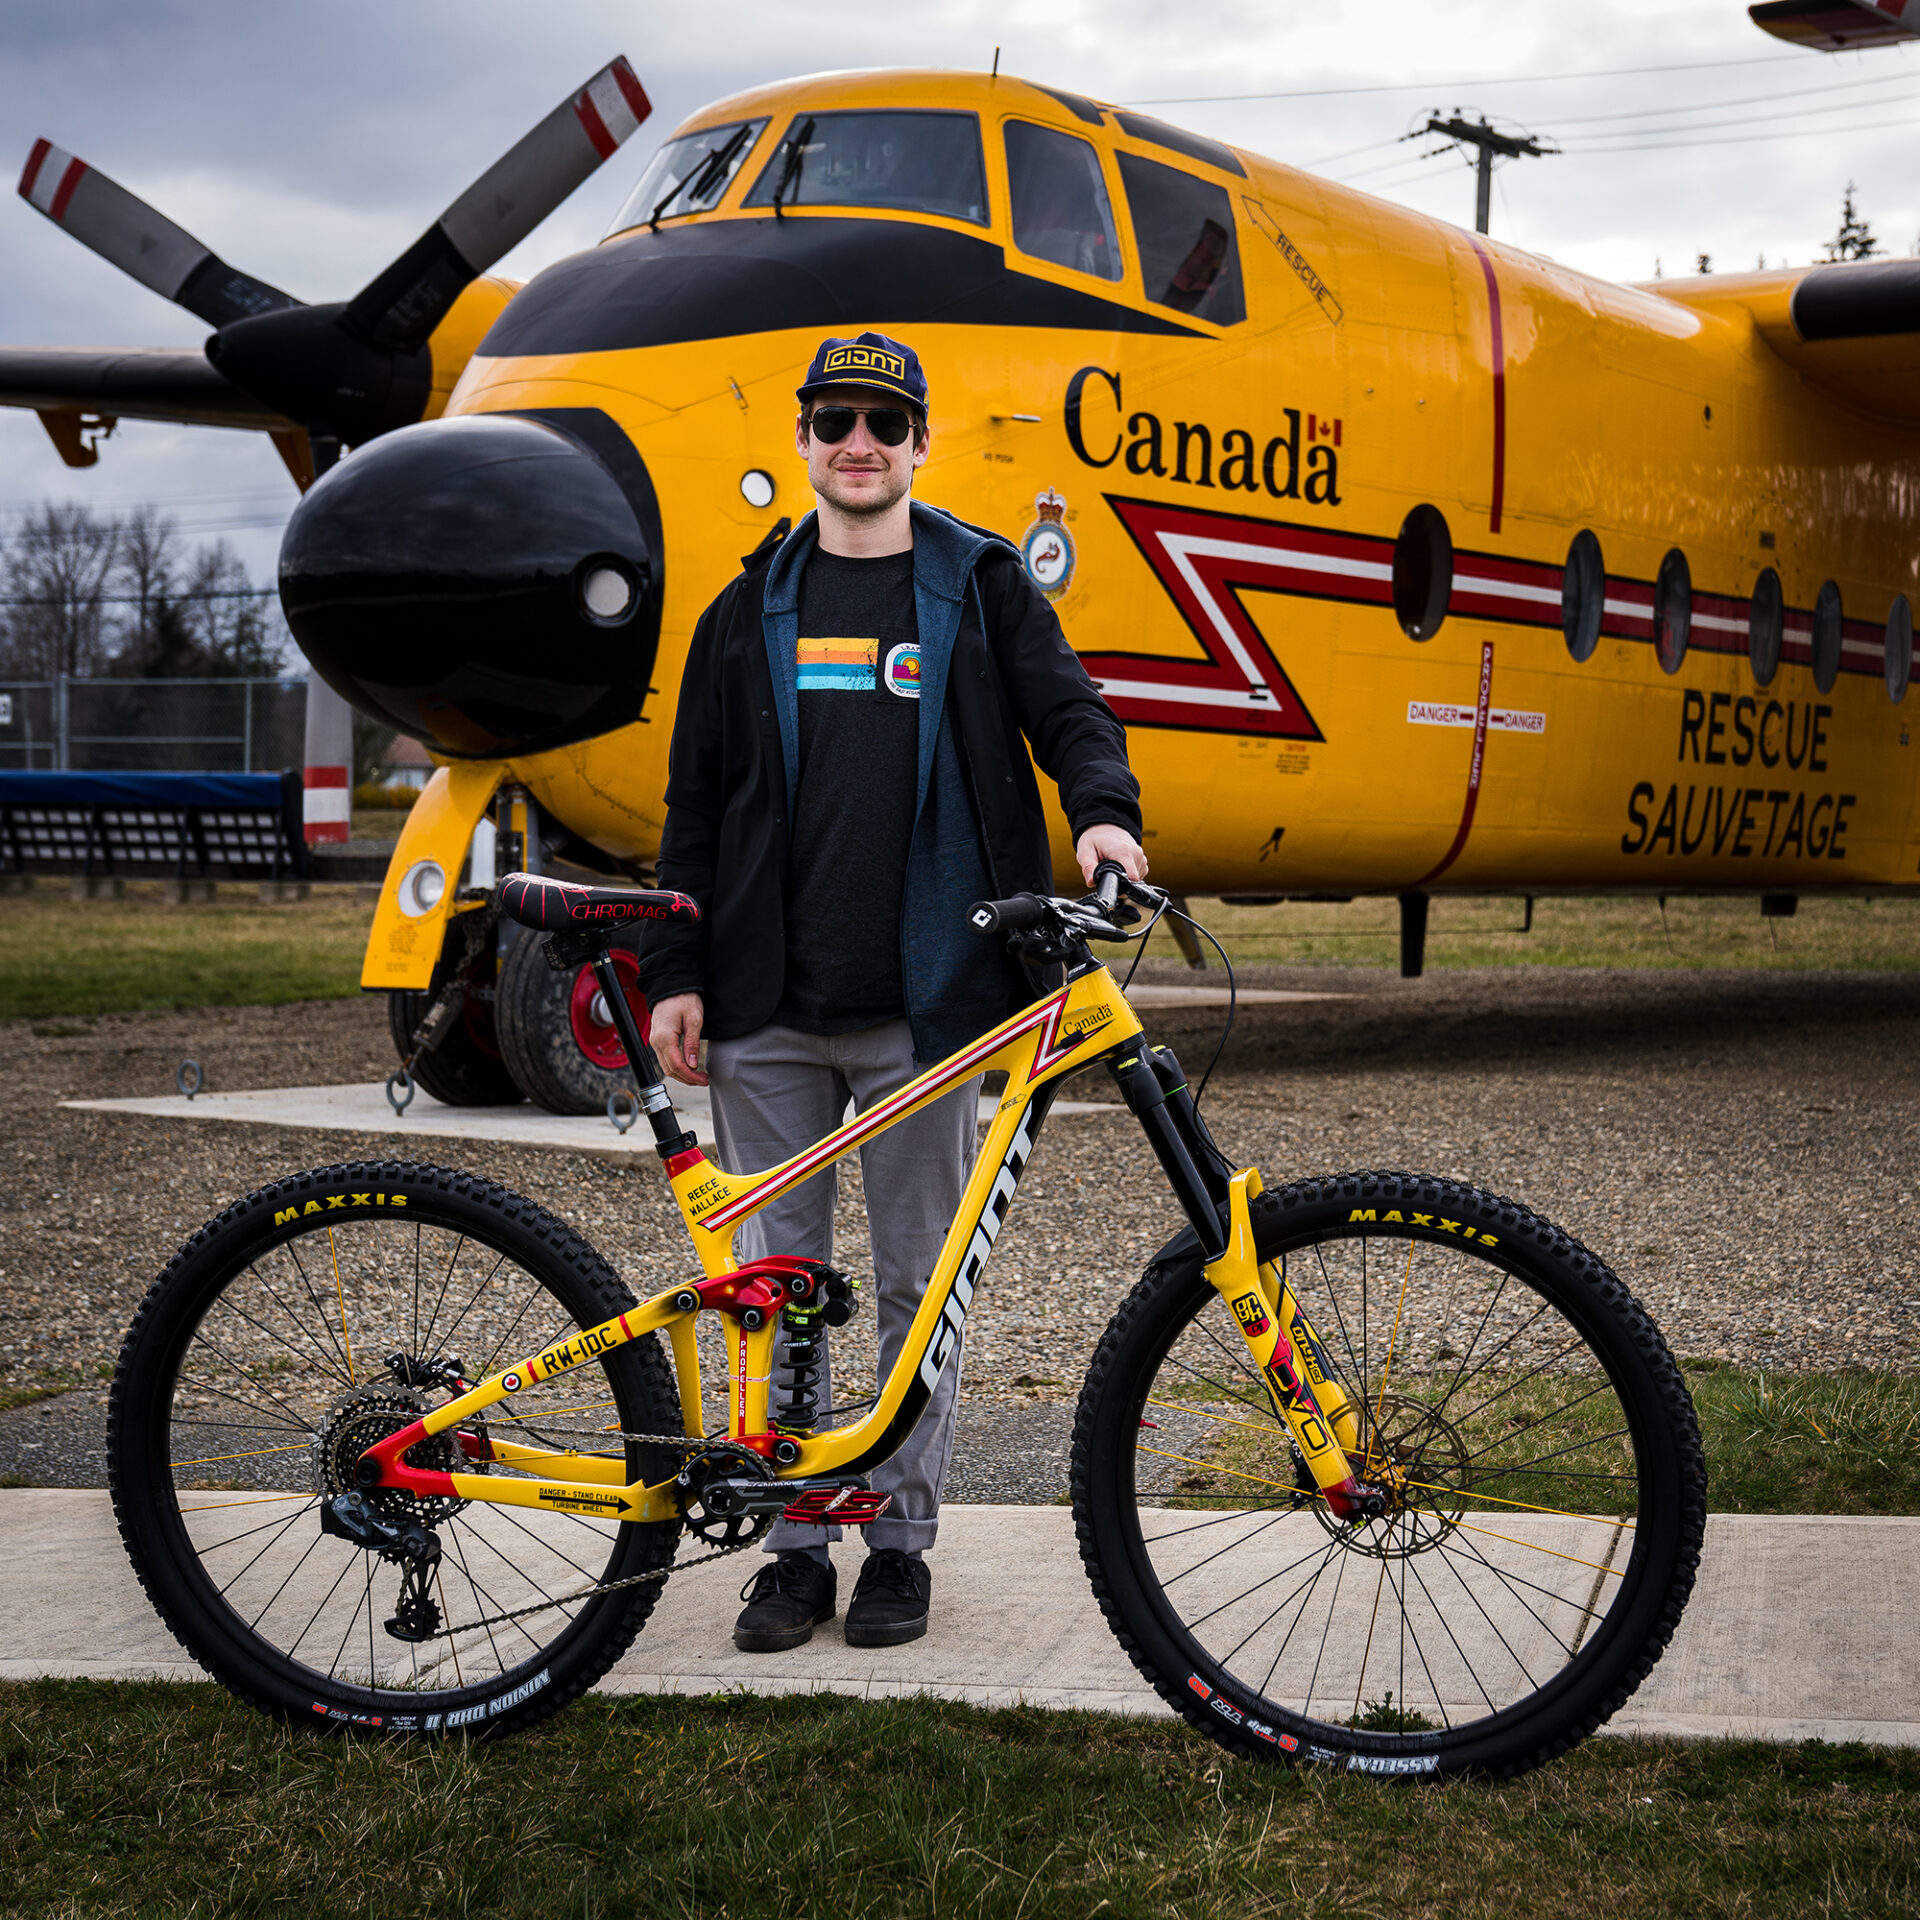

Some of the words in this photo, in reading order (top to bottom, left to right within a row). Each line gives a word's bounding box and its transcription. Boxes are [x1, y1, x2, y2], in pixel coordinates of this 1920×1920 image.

[1276, 233, 1326, 302] RESCUE
[829, 350, 900, 372] GIANT
[1064, 366, 1342, 507] Canada
[1410, 704, 1458, 723] DANGER
[1504, 713, 1543, 731] DANGER
[1678, 688, 1832, 772] RESCUE
[1621, 782, 1856, 859] SAUVETAGE
[571, 903, 668, 920] CHROMAG
[1063, 1007, 1113, 1036] Canada
[687, 1178, 719, 1202] REECE
[689, 1186, 731, 1216] WALLACE
[274, 1193, 408, 1226] MAXXIS
[1348, 1209, 1500, 1247] MAXXIS
[921, 1099, 1033, 1393] GIANT
[1268, 1356, 1328, 1451] DVO
[539, 1488, 566, 1496] DANGER
[573, 1491, 594, 1499] STAND
[596, 1493, 618, 1502] CLEAR
[552, 1501, 579, 1510] TURBINE
[582, 1503, 604, 1513] WHEEL
[489, 1668, 550, 1716] MINION
[1188, 1676, 1211, 1700] DD
[312, 1704, 327, 1714] DD
[447, 1704, 486, 1727] DHR
[1278, 1734, 1298, 1752] 3C
[1349, 1753, 1440, 1774] ASSEGAI
